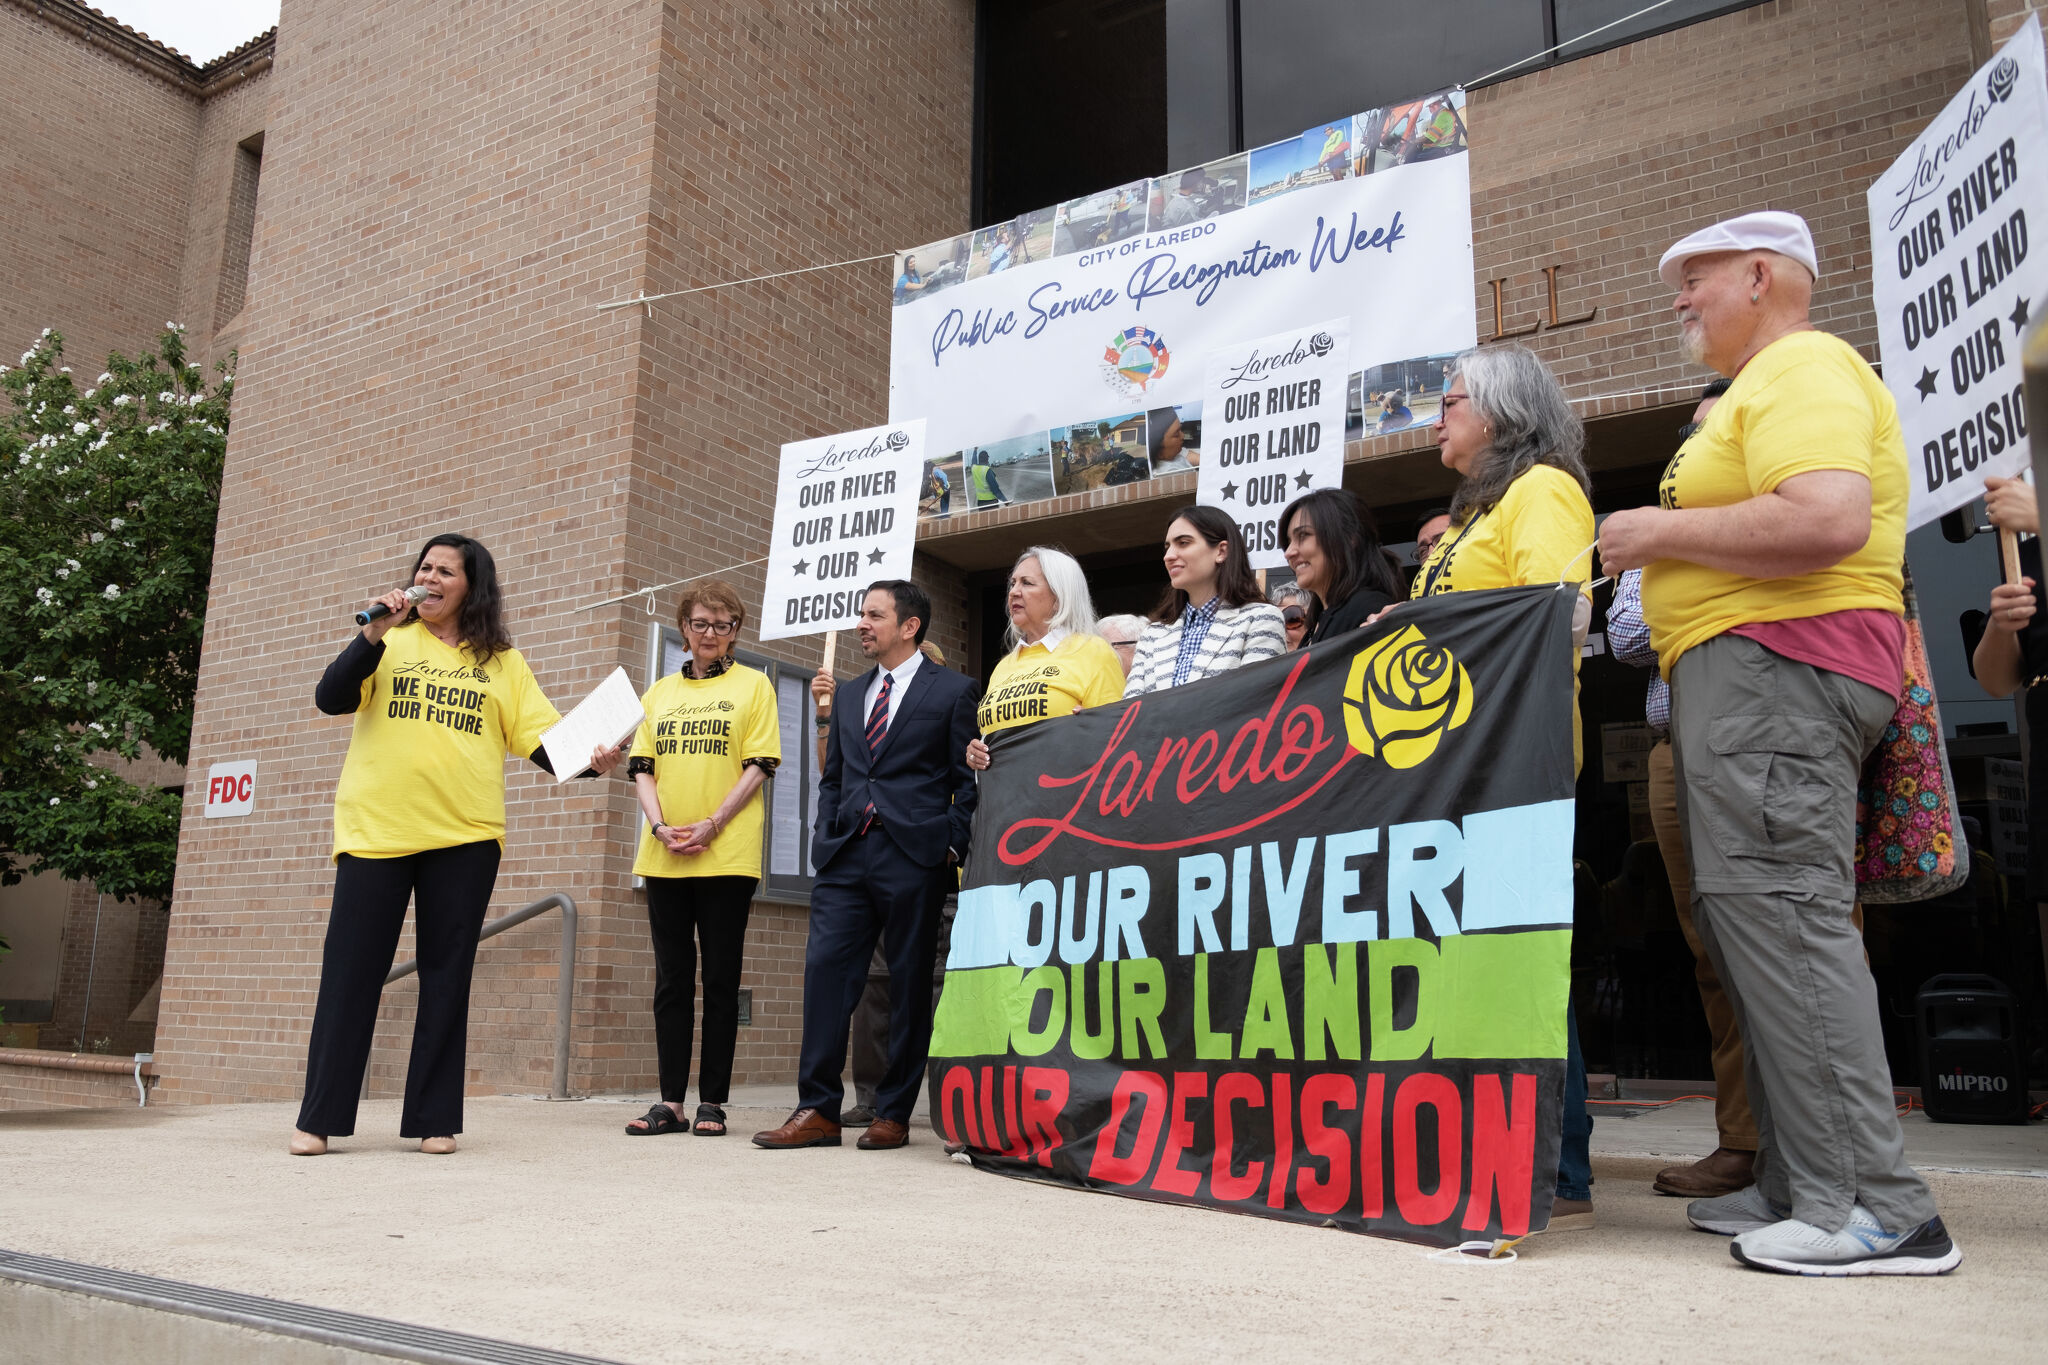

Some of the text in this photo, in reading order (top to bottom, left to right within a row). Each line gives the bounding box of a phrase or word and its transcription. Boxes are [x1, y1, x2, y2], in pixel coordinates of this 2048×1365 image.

[1889, 89, 1993, 231] Laredo
[1898, 137, 2018, 280] OUR RIVER
[1079, 222, 1217, 268] CITY OF LAREDO
[932, 211, 1406, 367] Public Service Recognition Week
[1902, 208, 2028, 351] OUR LAND
[1477, 265, 1597, 345] LL
[1221, 338, 1312, 389] Laredo
[1950, 317, 2005, 396] OUR
[1224, 378, 1321, 423] OUR RIVER
[796, 436, 886, 479] Laredo
[1220, 421, 1321, 468] OUR LAND
[1922, 383, 2029, 493] DECISIO
[799, 470, 896, 509] OUR RIVER
[1246, 473, 1287, 507] OUR
[792, 507, 895, 548] OUR LAND
[816, 551, 859, 581] OUR
[785, 589, 867, 626] DECISIO
[392, 659, 475, 681] Laredo
[392, 676, 487, 713] WE DECIDE
[658, 701, 718, 720] Laredo
[996, 699, 1048, 722] FUTURE
[997, 682, 1048, 702] DECIDE
[388, 700, 483, 736] OUR FUTURE
[656, 719, 731, 737] WE DECIDE
[655, 739, 729, 756] OUR FUTURE
[998, 651, 1360, 865] Laredo
[209, 773, 252, 805] FDC
[1017, 820, 1465, 965] OUR RIVER
[1010, 940, 1437, 1060] OUR LAND
[1939, 1070, 2008, 1092] MIPRO
[942, 1066, 1537, 1237] OUR DECISION
